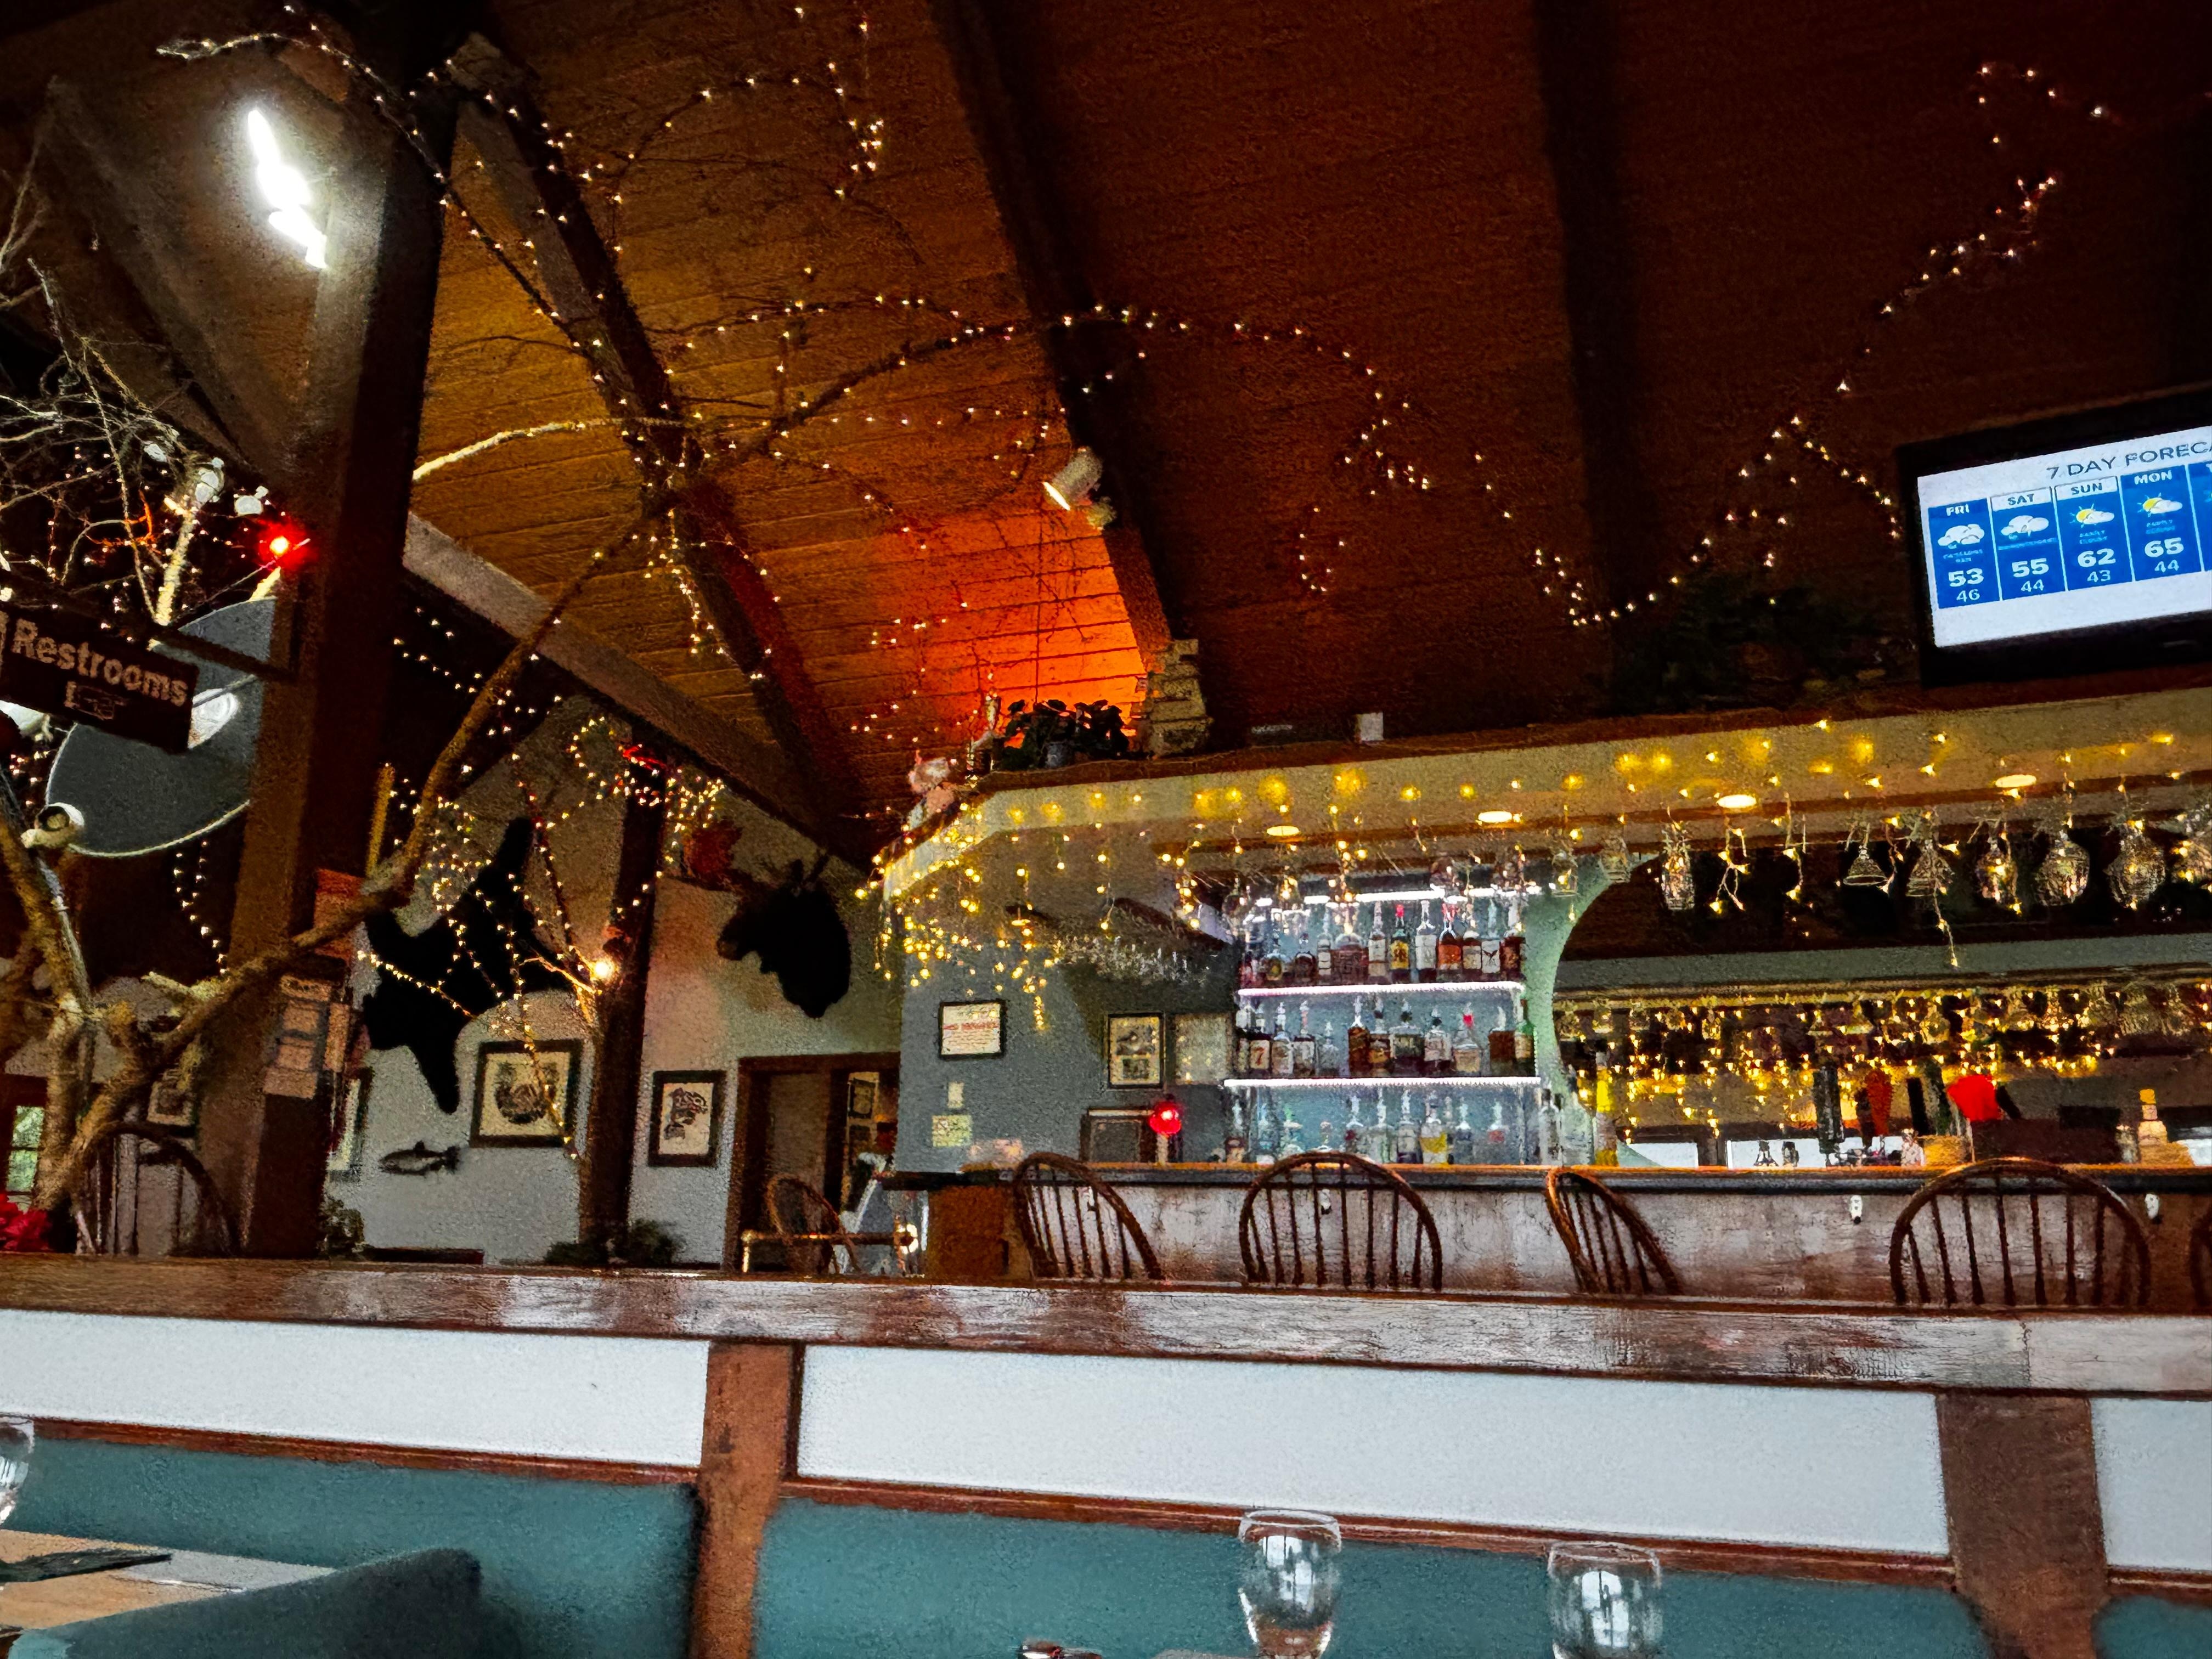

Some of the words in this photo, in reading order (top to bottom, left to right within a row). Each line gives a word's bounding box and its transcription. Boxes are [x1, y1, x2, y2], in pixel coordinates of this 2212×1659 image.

[2046, 467, 2058, 479] 7
[2067, 456, 2116, 476] DAY
[2125, 442, 2212, 466] FOREC
[2134, 470, 2172, 484] MON
[2070, 482, 2102, 495] SUN
[2007, 493, 2035, 506] SAT
[1946, 504, 1970, 516] FRI
[2145, 537, 2184, 557] 65
[2077, 548, 2116, 568] 62
[2012, 558, 2050, 578] 55
[2154, 560, 2180, 573] 44
[1948, 568, 1984, 587] 53
[2087, 570, 2111, 583] 43
[2021, 579, 2044, 592] 44
[1956, 589, 1980, 602] 46
[11, 618, 188, 707] Restrooms
